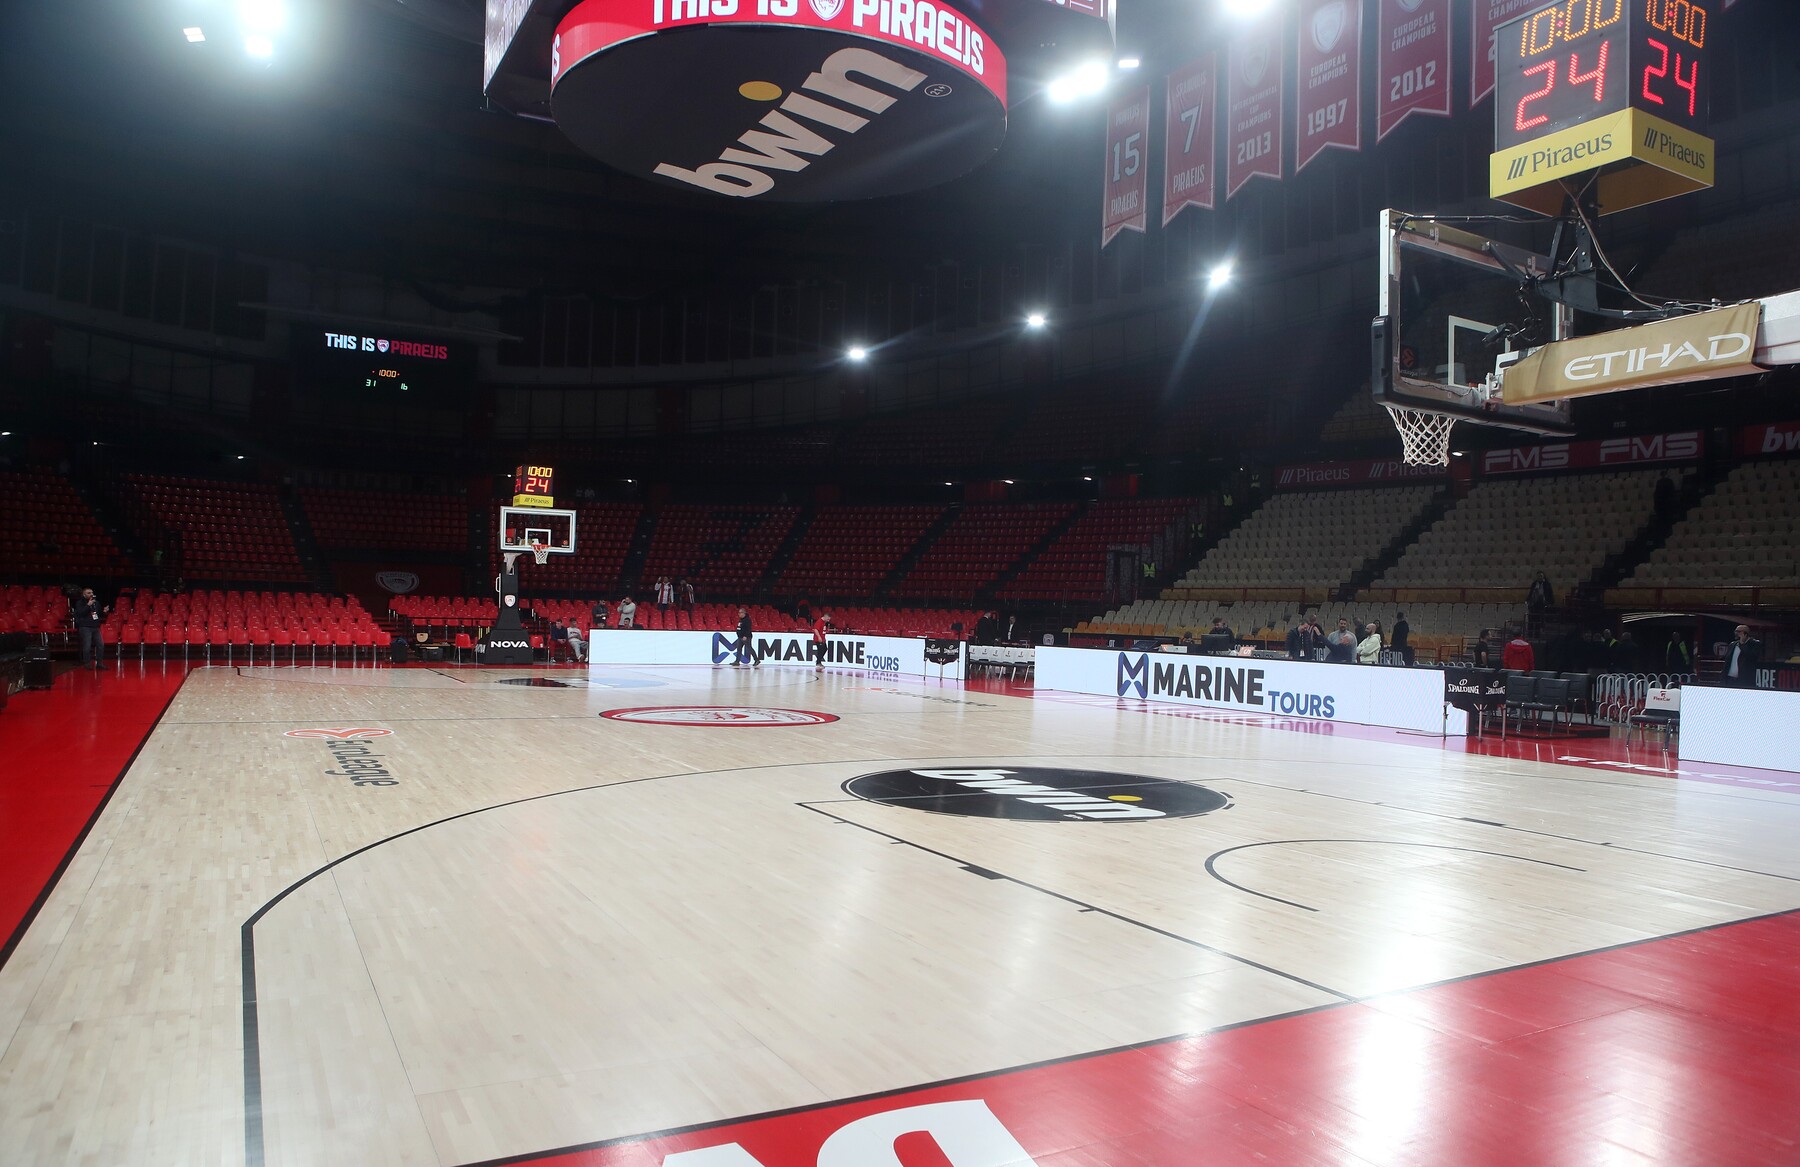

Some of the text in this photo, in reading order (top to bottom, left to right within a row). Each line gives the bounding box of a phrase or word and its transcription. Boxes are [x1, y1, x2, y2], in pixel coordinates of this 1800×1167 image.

[1391, 22, 1436, 52] CHAMPIONS
[1394, 11, 1435, 39] EUROPEAN
[1520, 0, 1622, 57] 10:00
[1308, 64, 1348, 89] CHAMPIONS
[1310, 52, 1347, 77] EUROPEAN
[1643, 38, 1698, 116] 24
[1390, 60, 1436, 102] 2012
[1515, 40, 1608, 131] 24
[653, 47, 928, 198] bwin
[1180, 104, 1202, 154] 7
[1237, 109, 1272, 132] CHAMPIONS
[1307, 98, 1348, 136] 1997
[1112, 132, 1141, 183] 15
[1237, 131, 1272, 165] 2013
[1532, 133, 1613, 173] Piraeus
[1659, 133, 1706, 170] Piraeus
[1172, 164, 1206, 194] PIRAEUS
[1110, 189, 1139, 217] PIRAEUS
[325, 333, 357, 350] THIS
[362, 337, 375, 352] IS
[1563, 332, 1751, 382] ETIHAD
[1485, 443, 1569, 472] FMS
[1599, 431, 1698, 462] FMS
[527, 465, 553, 478] 10:00
[1296, 467, 1351, 483] Piraeus
[1388, 461, 1448, 478] Piraeus
[525, 477, 549, 493] 24
[490, 640, 529, 648] NOVA
[758, 638, 900, 672] MARINE TOURS
[1153, 662, 1335, 719] MARINE TOURS
[1448, 683, 1480, 695] SPALDING
[1755, 668, 1776, 689] ARE
[910, 769, 1166, 819] bwin
